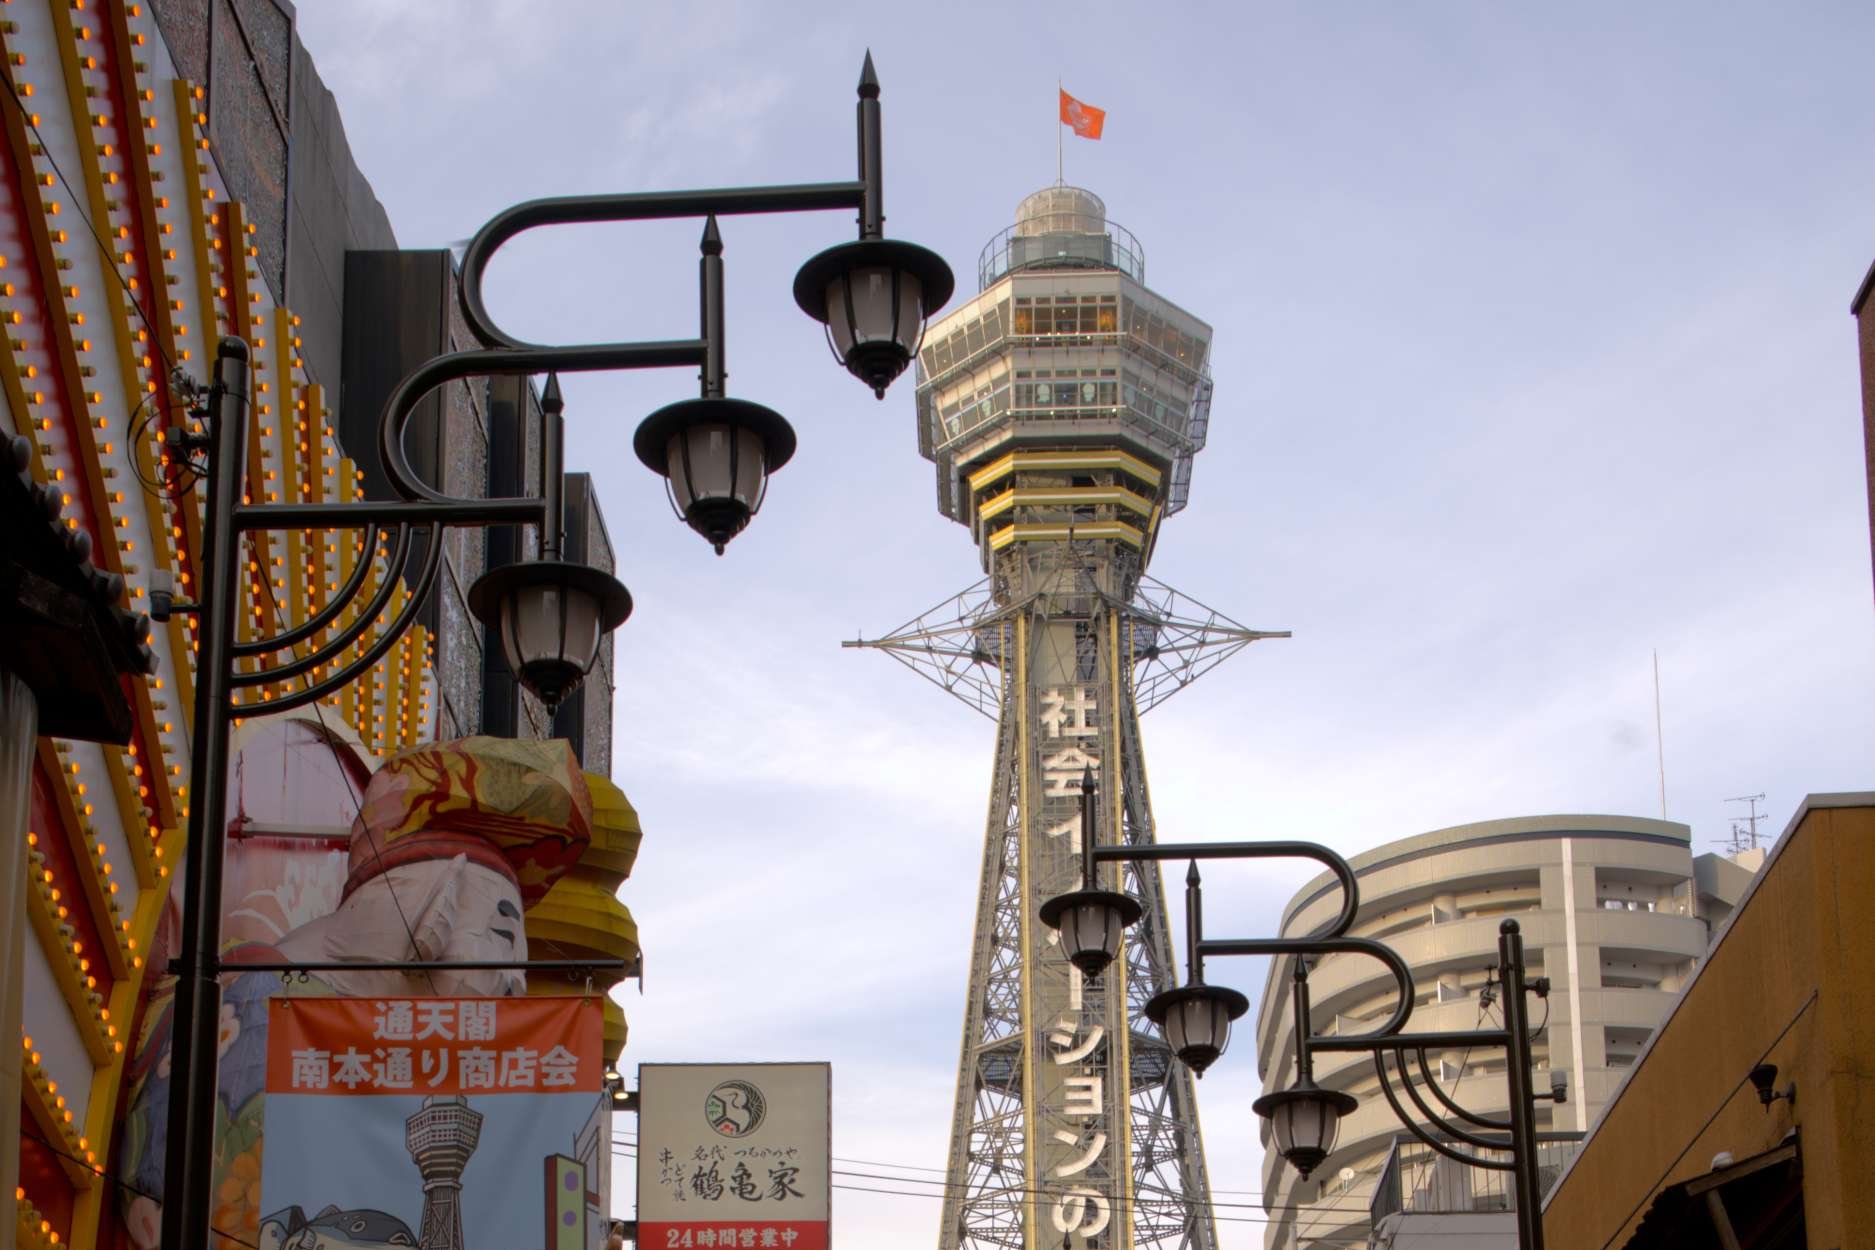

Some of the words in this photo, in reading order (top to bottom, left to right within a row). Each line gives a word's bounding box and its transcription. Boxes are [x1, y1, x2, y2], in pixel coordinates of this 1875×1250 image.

[373, 1000, 496, 1041] 通天閣
[291, 1045, 579, 1089] 南本通り商店会
[691, 1161, 805, 1201] 鶴亀家
[667, 1228, 798, 1248] 24時間営業中
